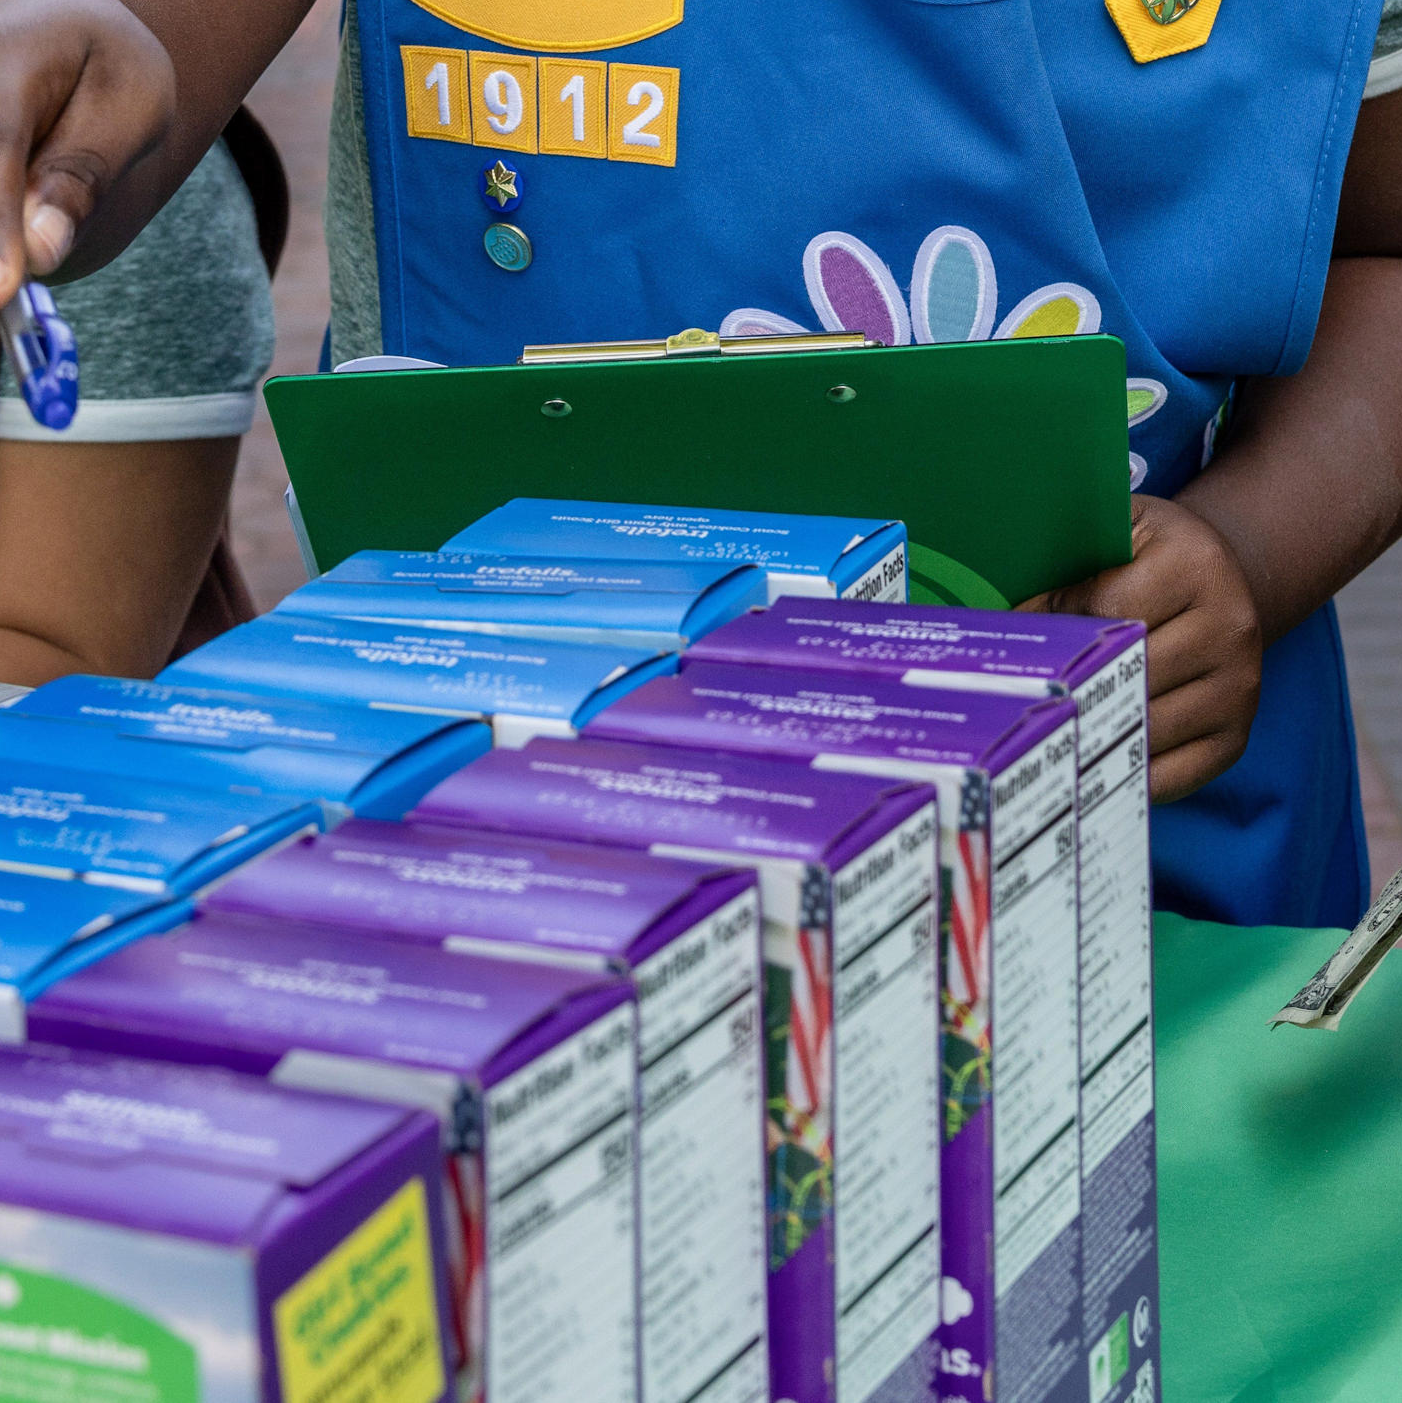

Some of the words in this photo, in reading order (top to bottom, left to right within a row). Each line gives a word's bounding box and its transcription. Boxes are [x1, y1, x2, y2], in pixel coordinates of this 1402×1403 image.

[424, 62, 665, 147] 1912
[643, 514, 675, 522] here
[677, 515, 710, 524] open
[624, 519, 656, 527] from
[658, 520, 688, 528] only
[753, 527, 790, 536] Scout
[883, 552, 904, 588] Facts
